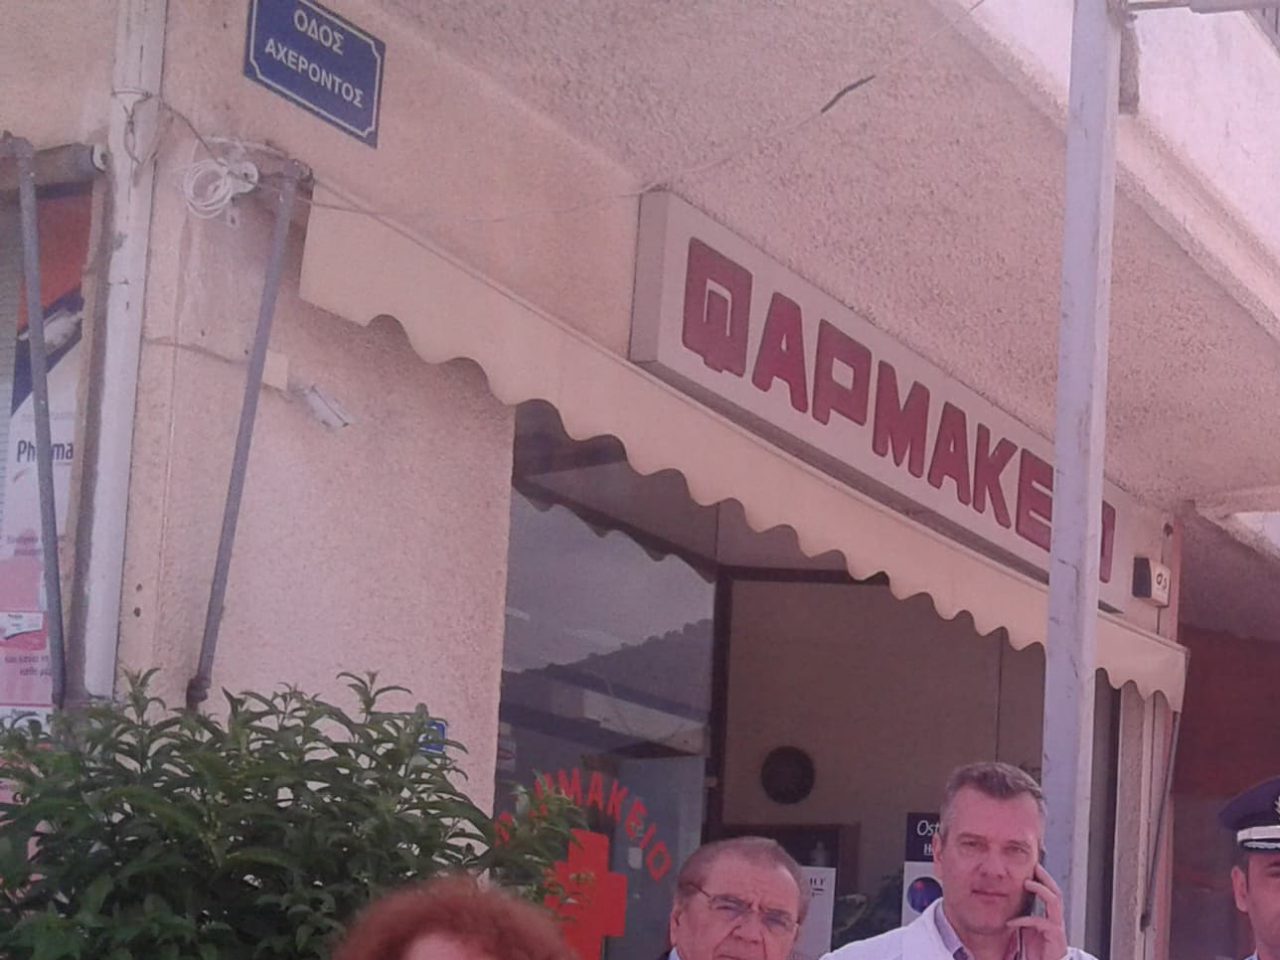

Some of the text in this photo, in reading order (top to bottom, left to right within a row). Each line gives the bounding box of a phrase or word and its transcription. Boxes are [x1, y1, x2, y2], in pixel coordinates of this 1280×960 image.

[293, 9, 345, 55] ΟΔΟΣ
[264, 38, 364, 108] ΑΧΕΡΟΝΤΟΣ
[682, 236, 1116, 583] ΦΑΡΜΑΚΕ
[16, 440, 74, 463] Phma
